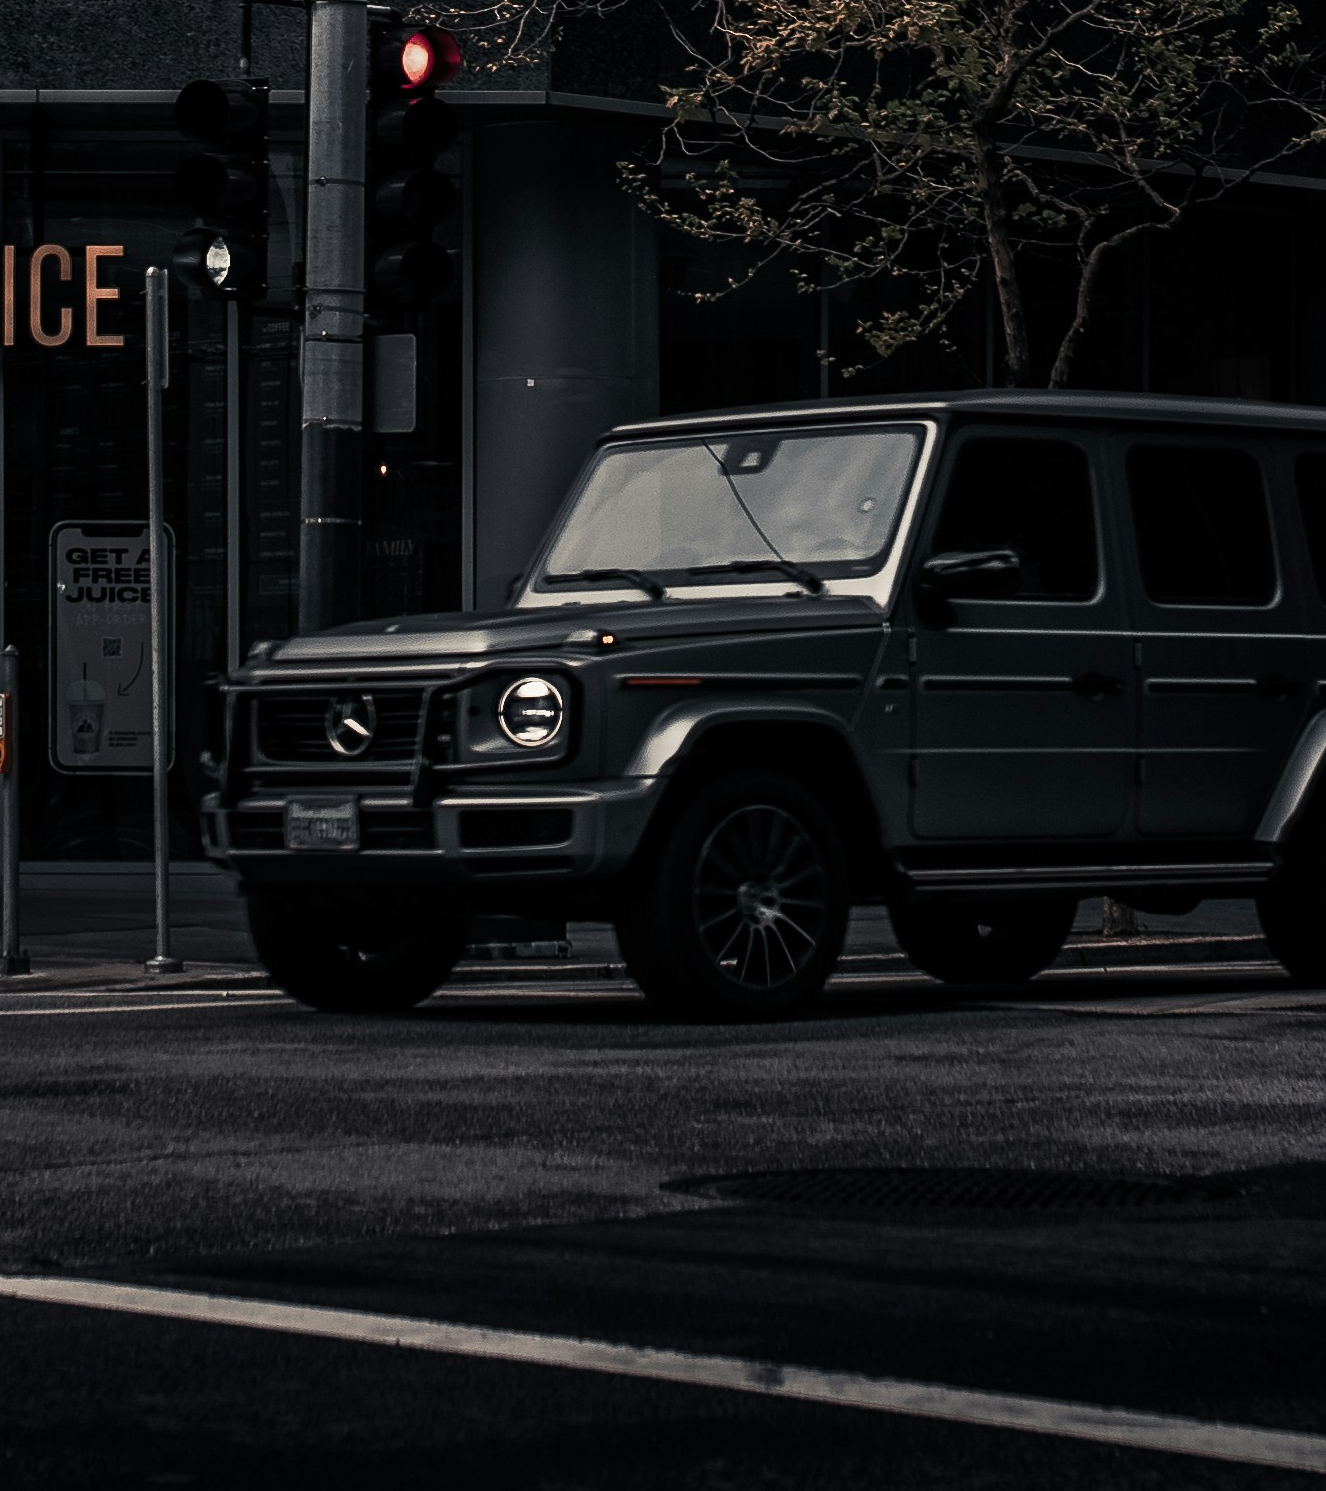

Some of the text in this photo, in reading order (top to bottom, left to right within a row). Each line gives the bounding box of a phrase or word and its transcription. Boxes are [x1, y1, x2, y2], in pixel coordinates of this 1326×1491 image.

[65, 548, 151, 565] GET A
[72, 567, 151, 584] FREE
[65, 586, 151, 604] JUICE
